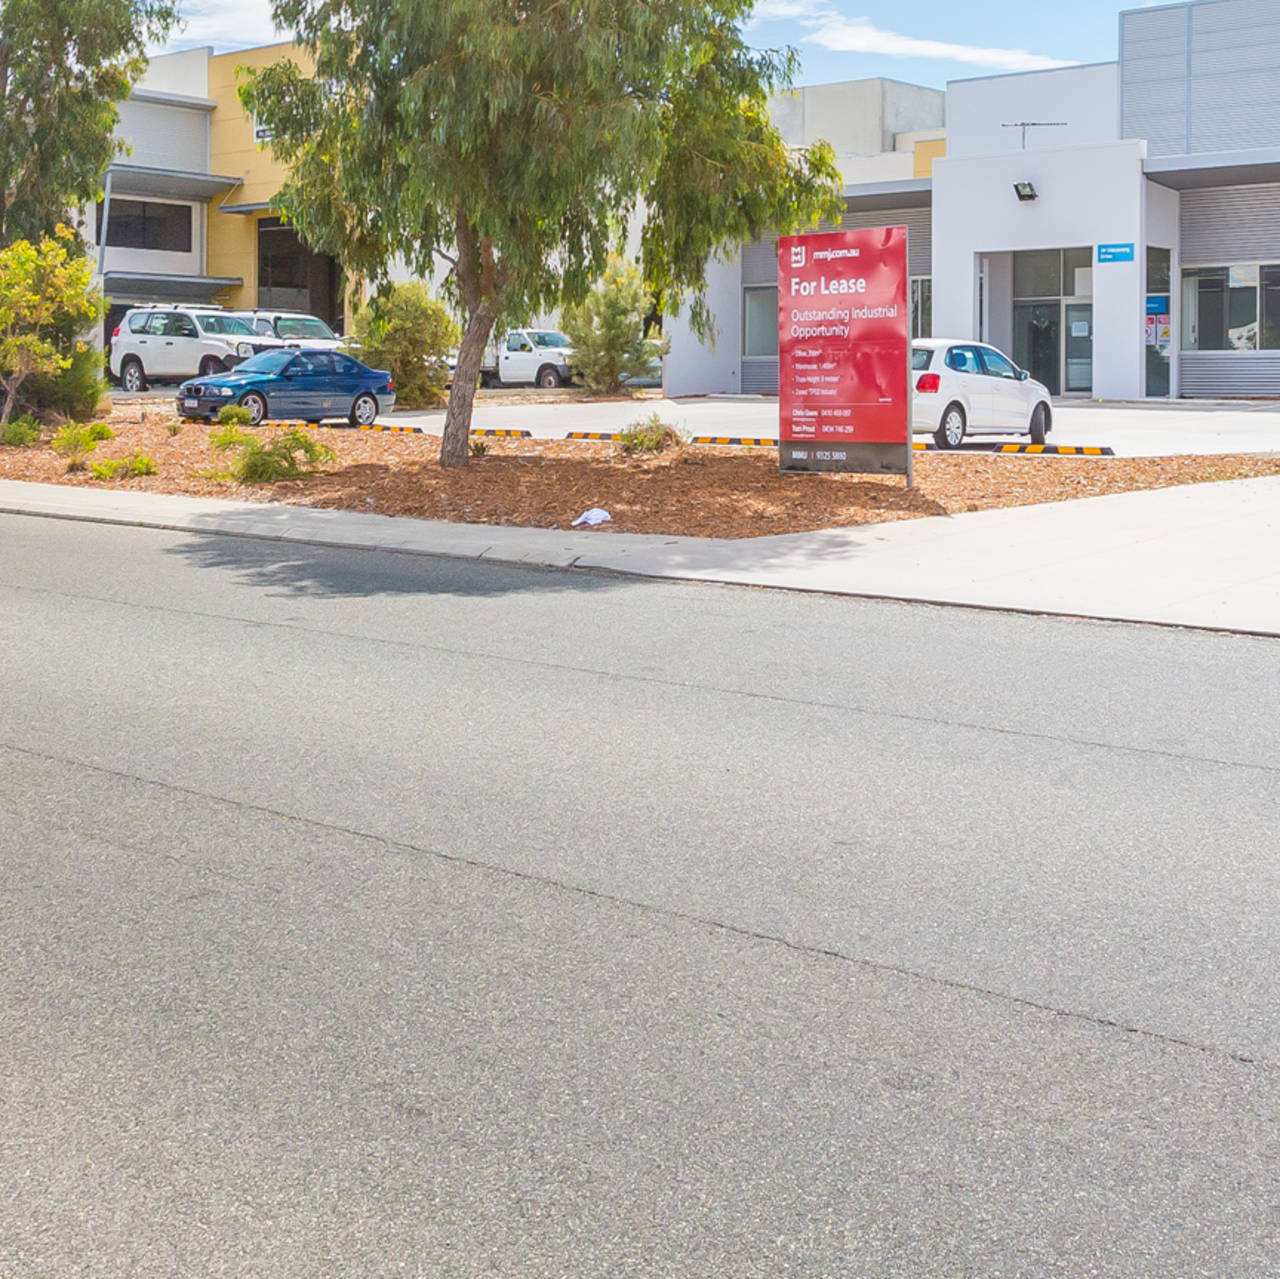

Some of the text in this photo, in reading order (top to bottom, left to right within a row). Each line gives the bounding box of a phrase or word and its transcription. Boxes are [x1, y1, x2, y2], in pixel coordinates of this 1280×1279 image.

[813, 248, 860, 261] mmj.com.au
[791, 276, 867, 296] For Lease
[791, 304, 898, 323] Outstanding Industrial
[791, 324, 850, 339] Opportunity
